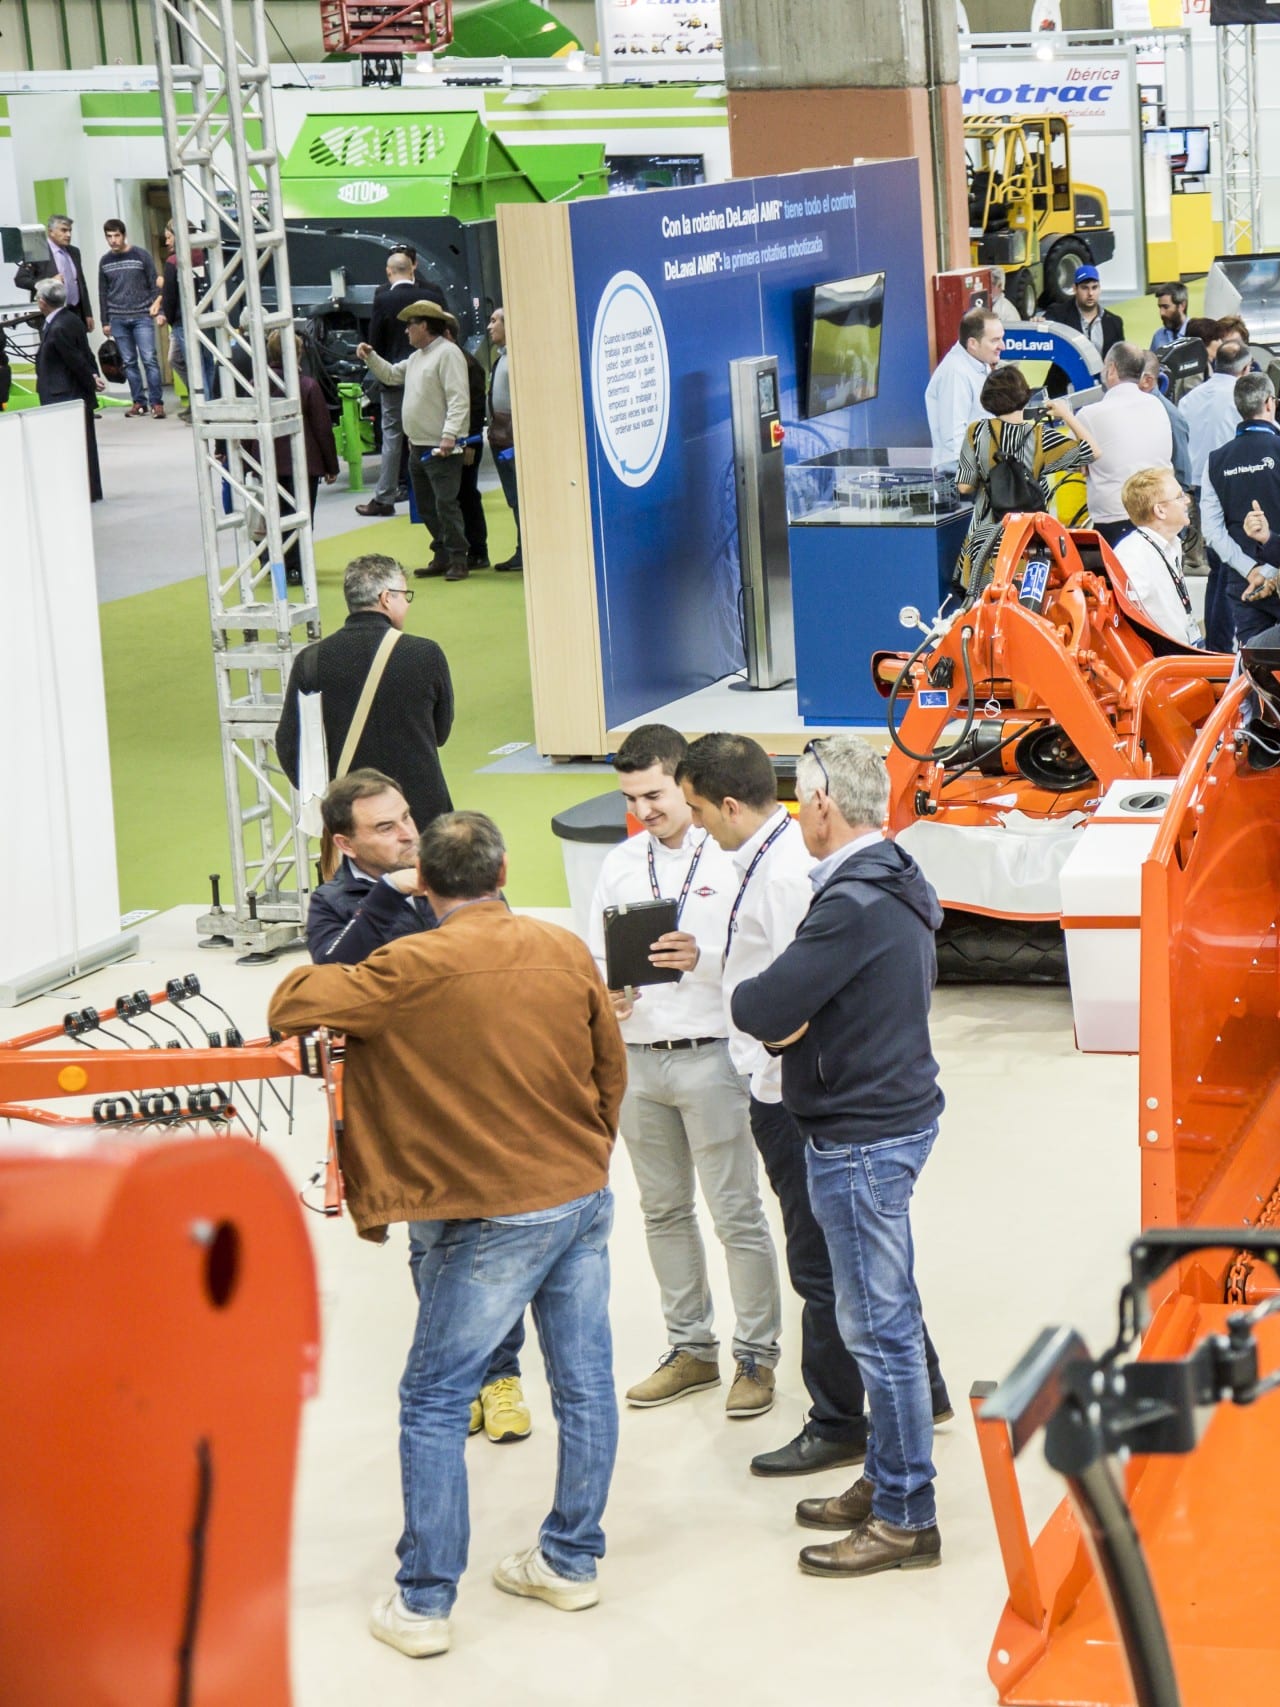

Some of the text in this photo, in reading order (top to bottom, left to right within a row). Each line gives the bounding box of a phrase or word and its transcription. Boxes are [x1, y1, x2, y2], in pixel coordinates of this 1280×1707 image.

[1066, 67, 1121, 81] Ibérica
[662, 215, 681, 238] Con
[682, 213, 691, 234] la
[692, 209, 726, 234] rotativa
[726, 202, 760, 229] DeLaval
[783, 199, 803, 219] tiene
[804, 195, 822, 215] todo
[822, 193, 830, 213] el
[831, 189, 856, 211] control
[664, 256, 697, 281] DeLaval
[723, 251, 731, 269] la
[731, 248, 760, 273] primera
[761, 242, 787, 264] rotativa
[788, 236, 823, 258] robotizada
[1006, 339, 1053, 351] DeLaval
[1223, 464, 1264, 477] Herd Navigator
